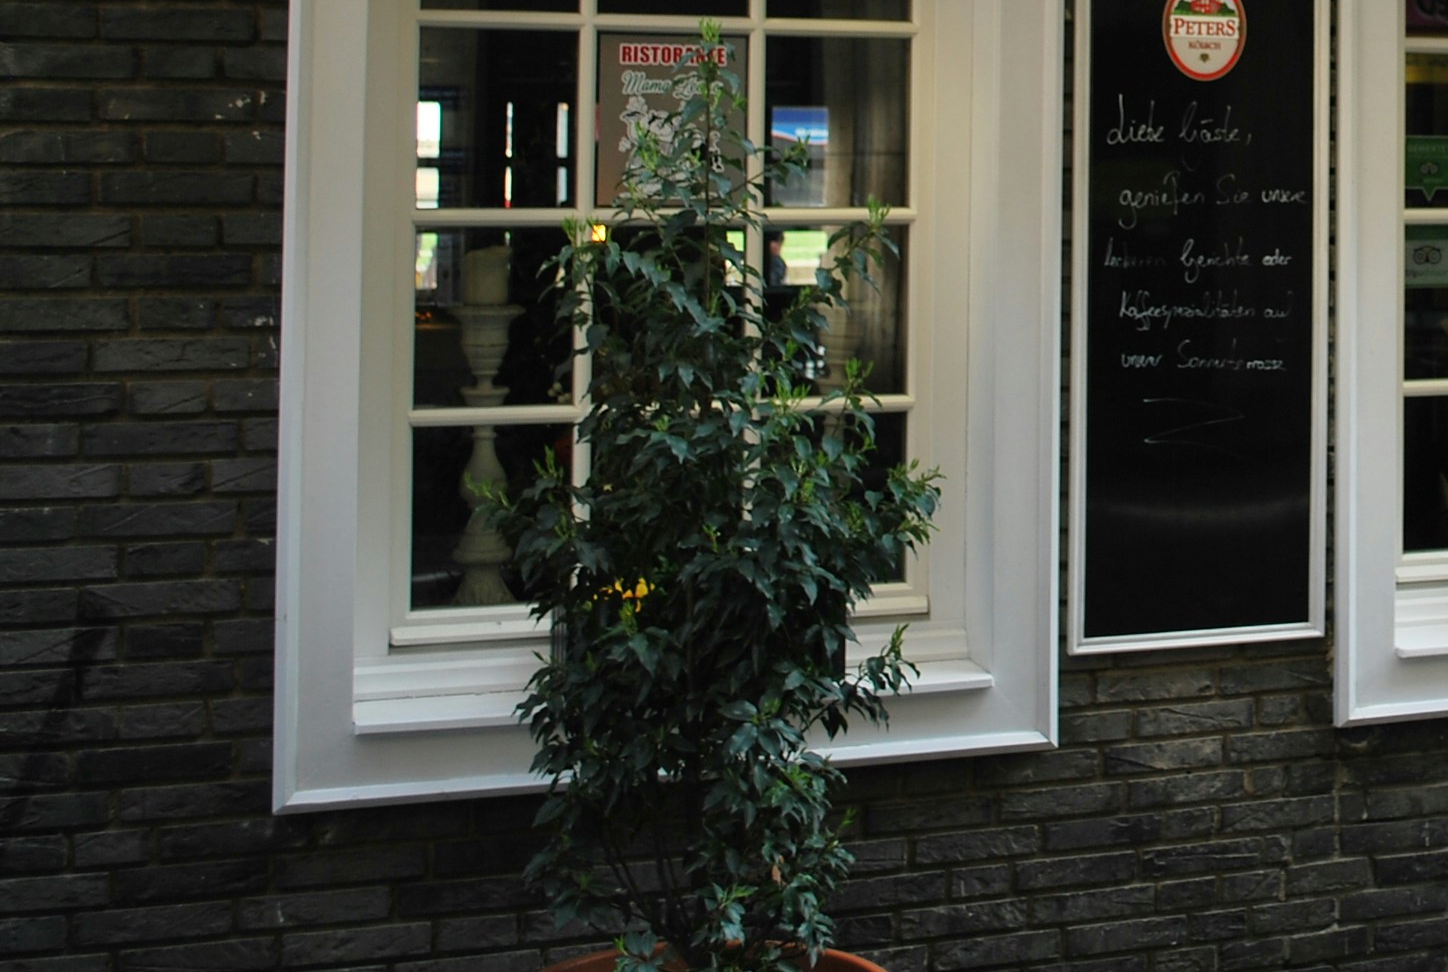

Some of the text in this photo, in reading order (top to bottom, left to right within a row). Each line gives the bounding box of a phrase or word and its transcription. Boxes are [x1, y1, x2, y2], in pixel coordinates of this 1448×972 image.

[1173, 18, 1236, 37] PETERS
[1216, 173, 1251, 205] Sie
[1261, 247, 1293, 267] oder
